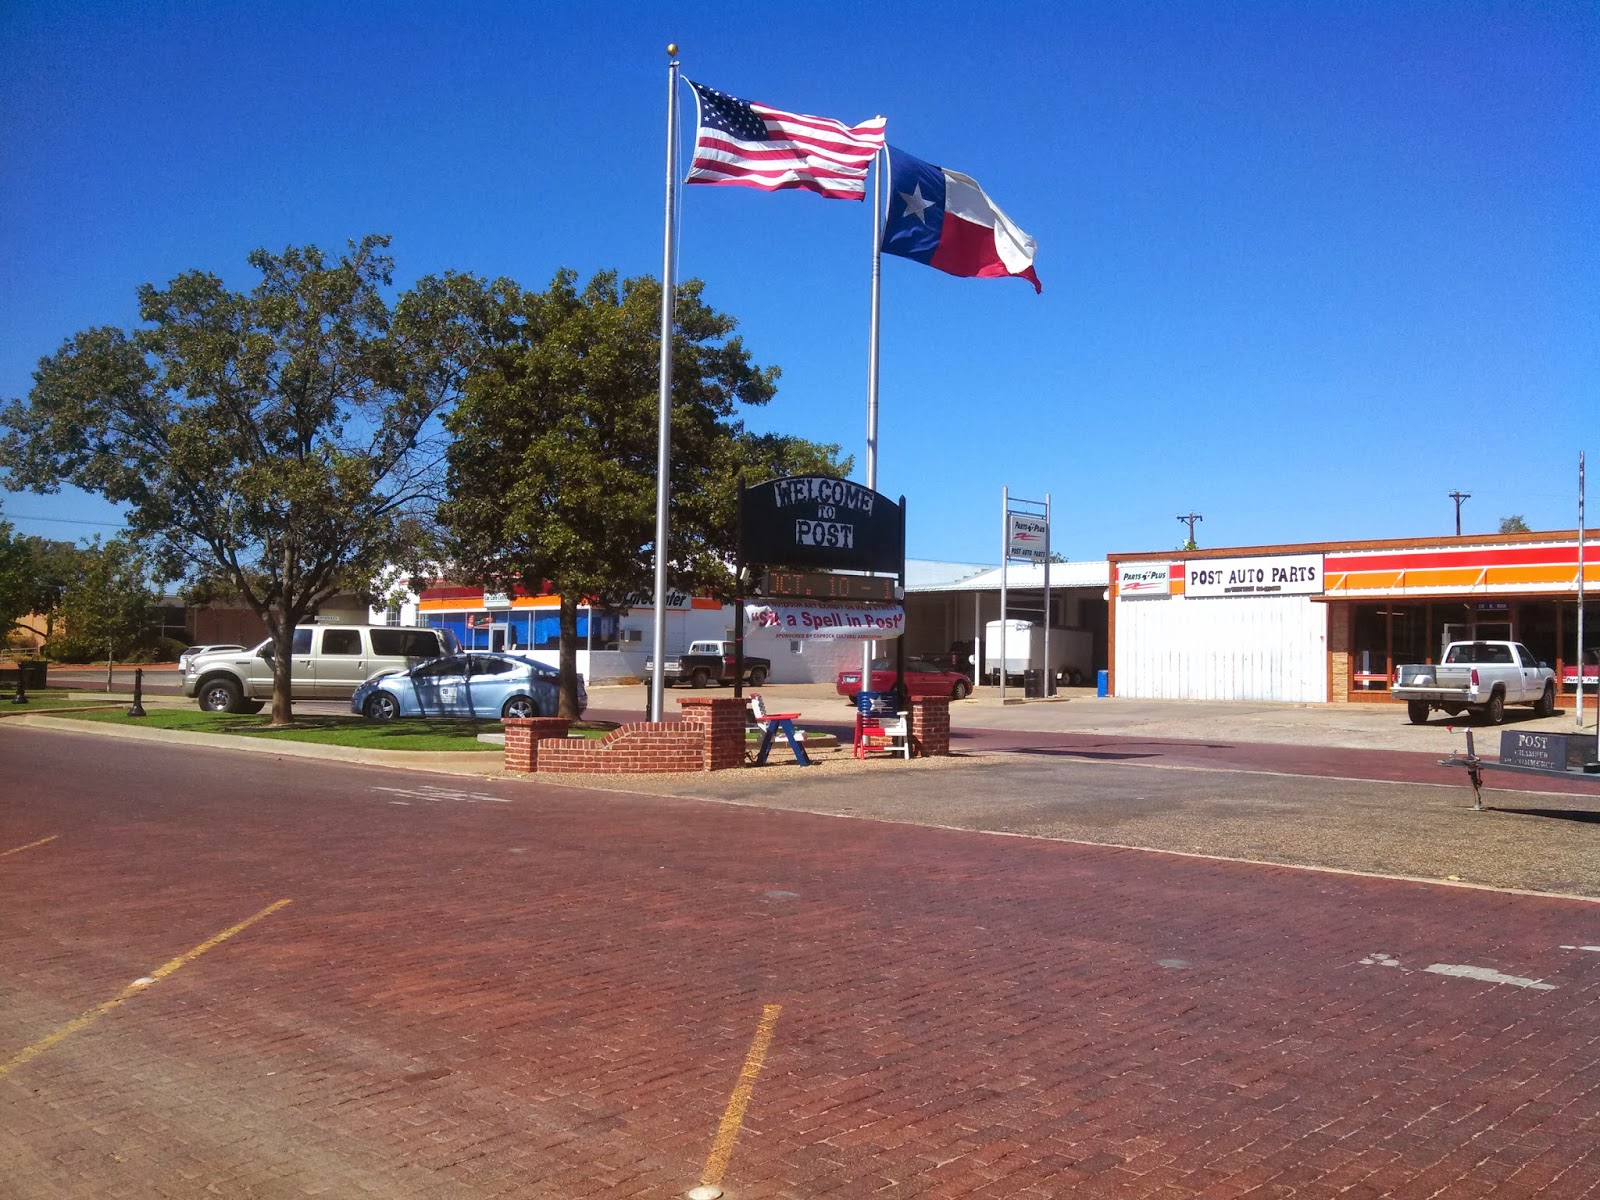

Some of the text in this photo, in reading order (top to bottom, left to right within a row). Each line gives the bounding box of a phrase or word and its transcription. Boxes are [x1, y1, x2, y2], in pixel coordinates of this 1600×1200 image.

[775, 478, 873, 514] WELCOME
[819, 505, 836, 519] TO
[796, 519, 853, 548] POST
[1191, 566, 1316, 586] POST AUTO PARTS
[787, 614, 797, 626] a
[801, 611, 842, 630] Spell
[845, 613, 861, 627] in
[1518, 734, 1548, 749] POST
